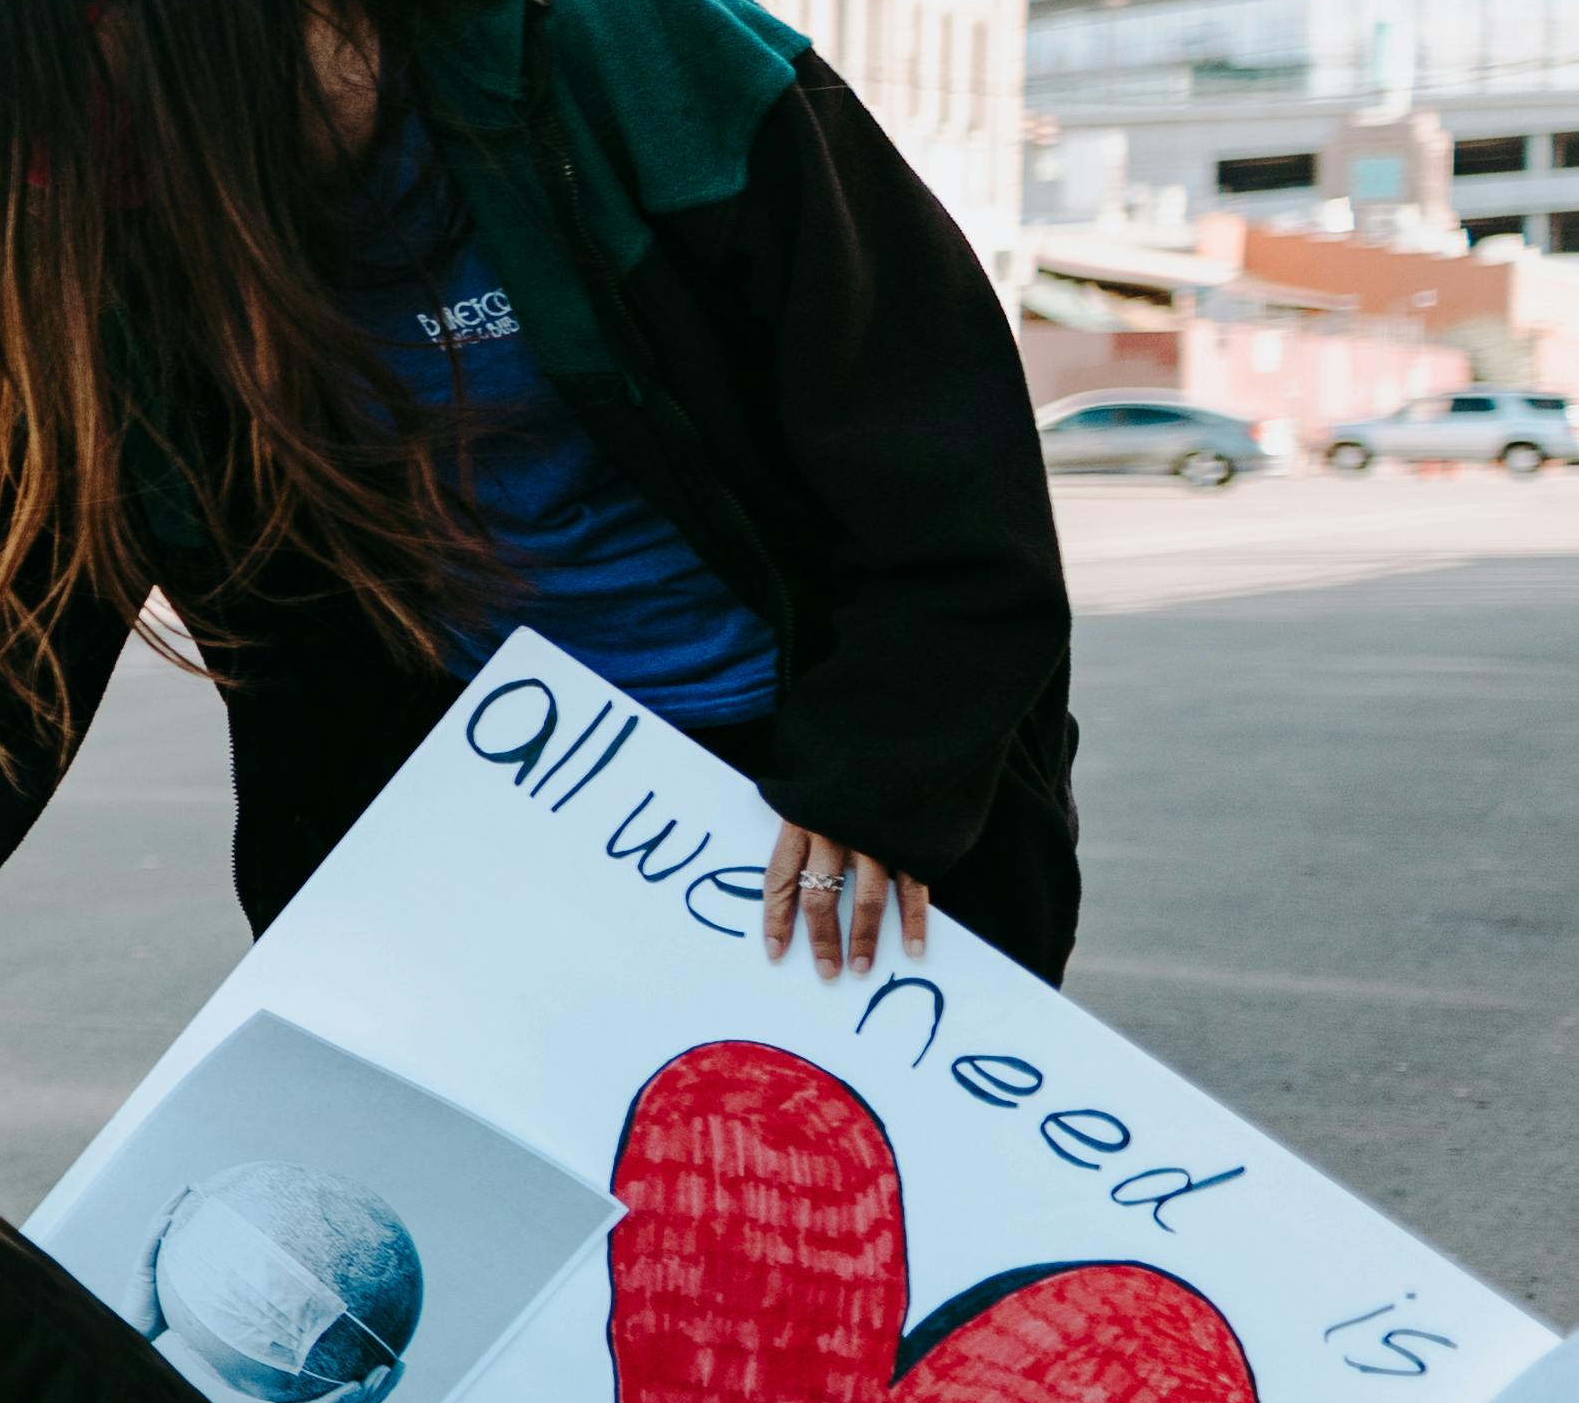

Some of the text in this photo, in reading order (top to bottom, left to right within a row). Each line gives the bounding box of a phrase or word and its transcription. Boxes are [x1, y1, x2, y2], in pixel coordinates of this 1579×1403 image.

[465, 677, 1458, 1376] all we need is
